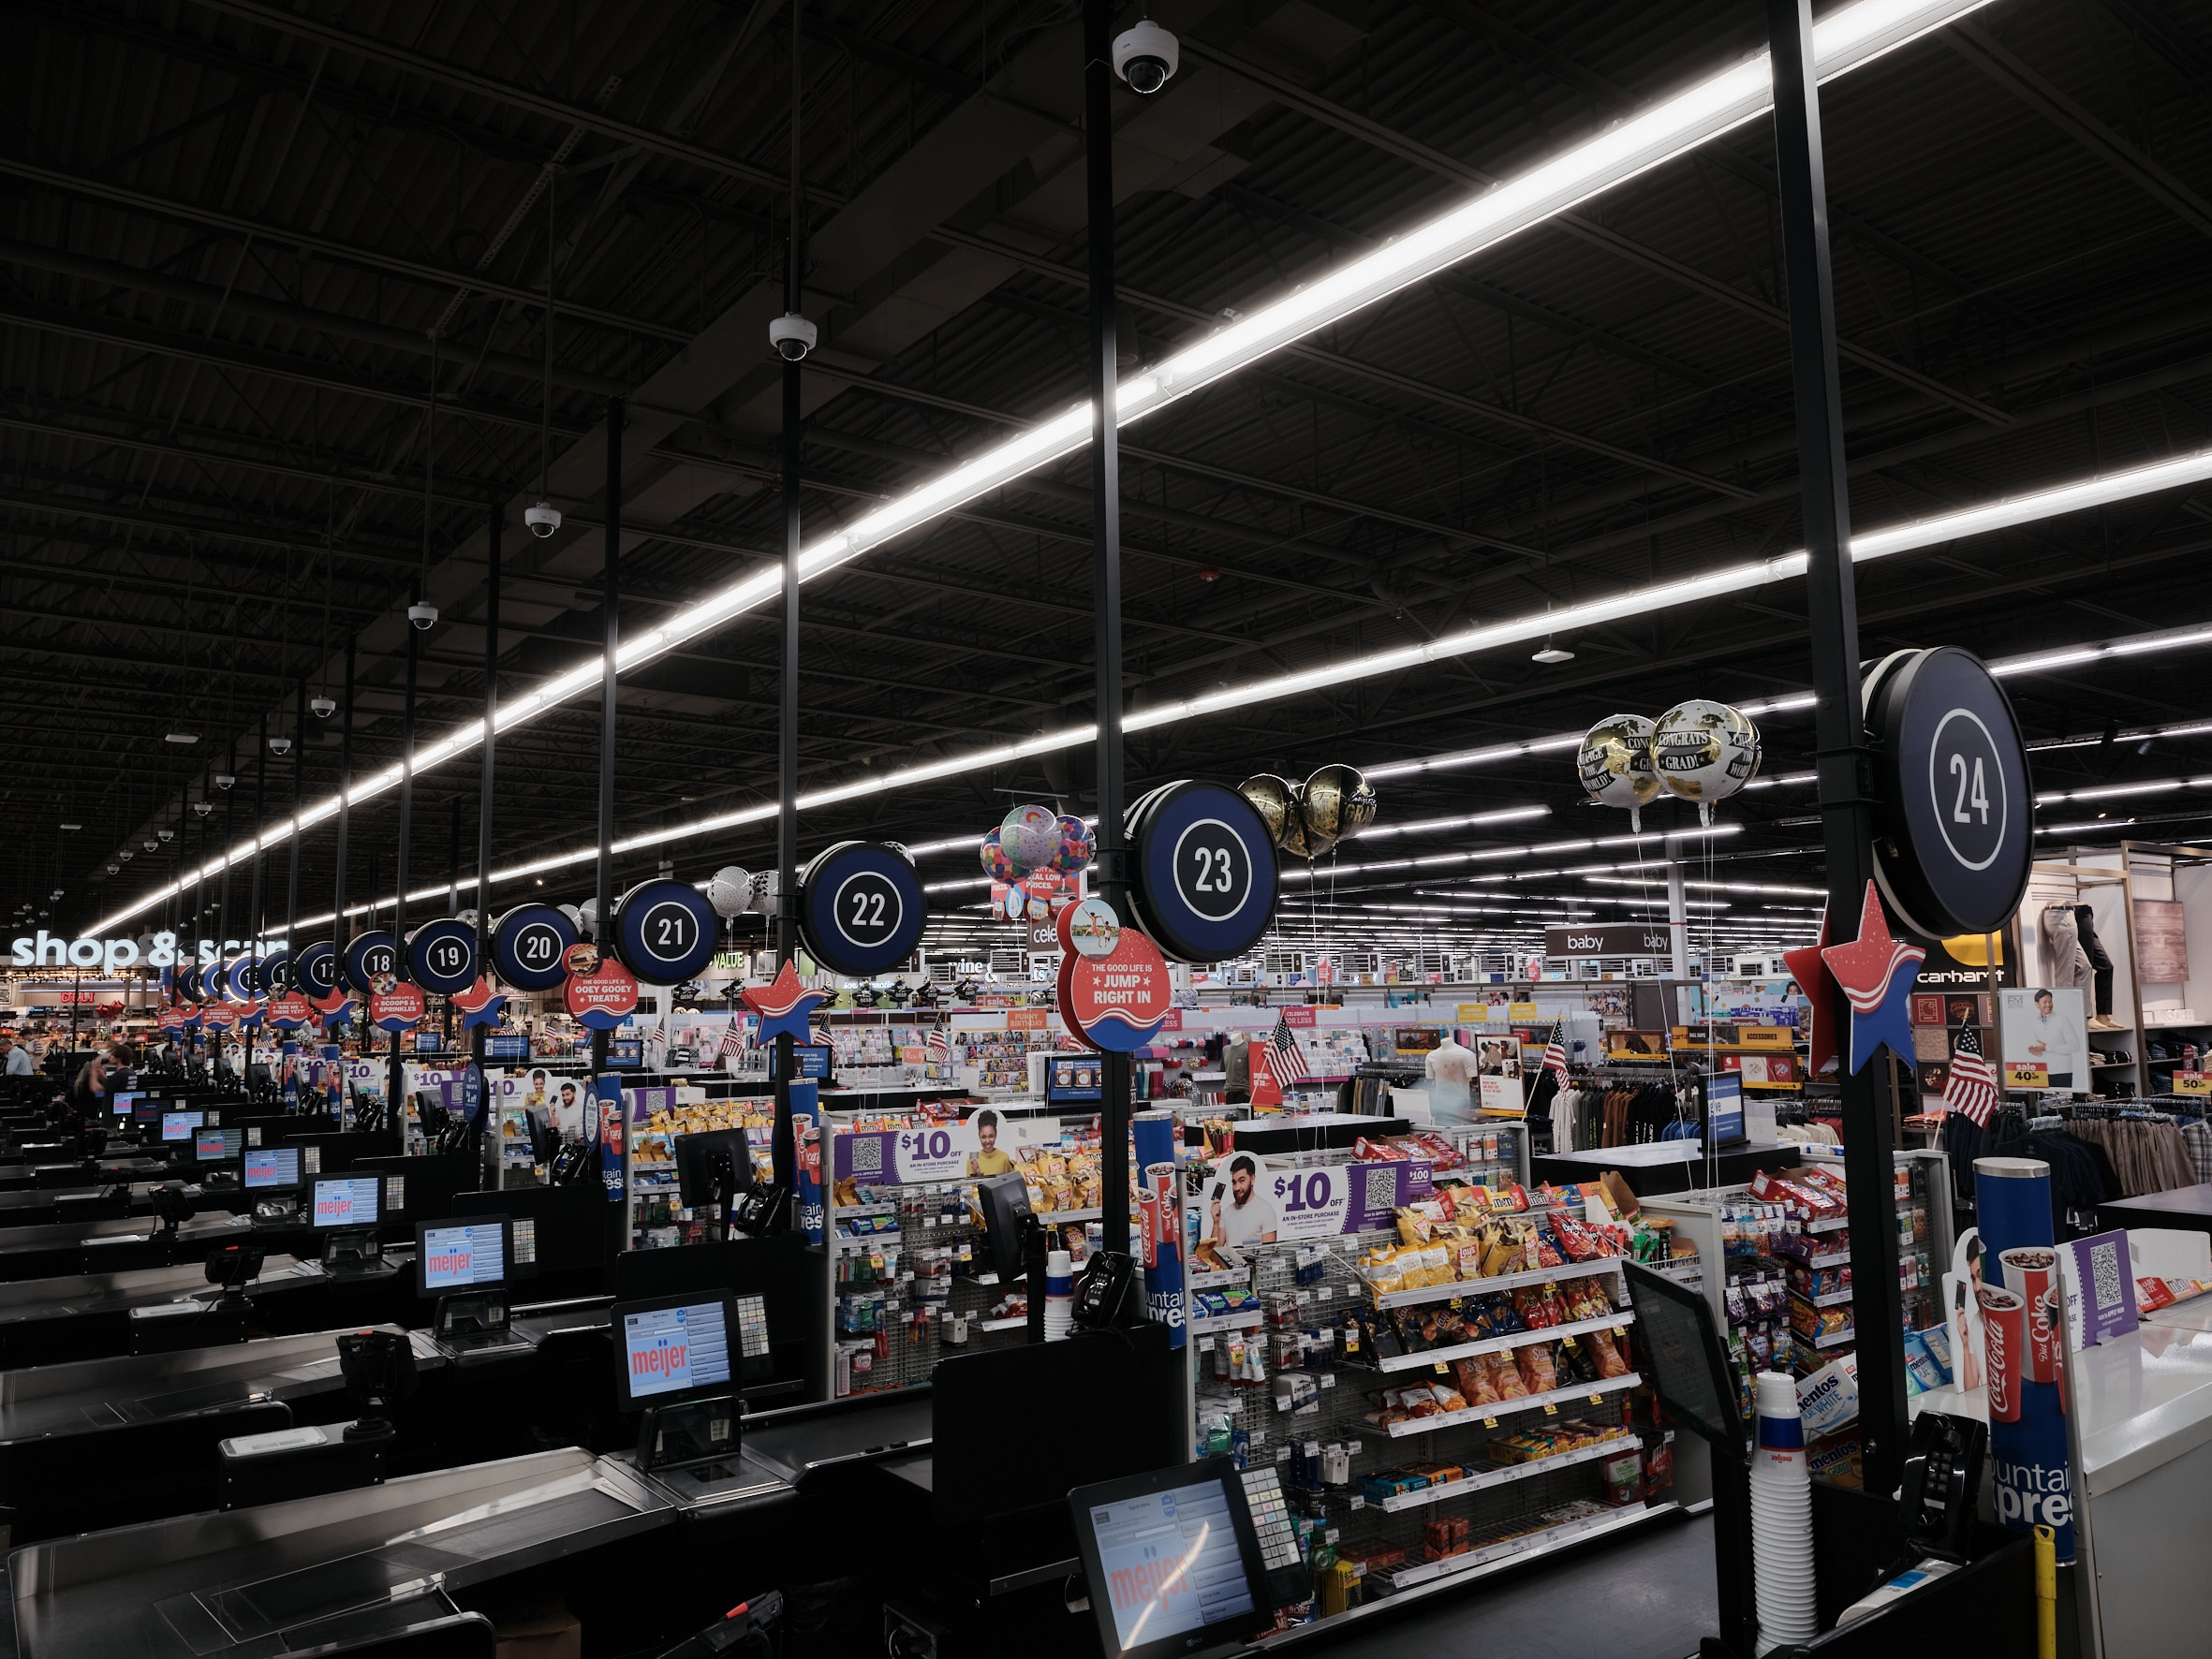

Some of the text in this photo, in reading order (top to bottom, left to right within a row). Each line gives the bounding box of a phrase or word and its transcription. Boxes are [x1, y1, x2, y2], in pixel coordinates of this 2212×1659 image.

[1657, 730, 1708, 747] CONGRATS
[1665, 754, 1700, 771] GRAD!
[1950, 753, 1989, 825] 24
[1045, 874, 1061, 882] LOW
[1194, 846, 1232, 893] 23
[1025, 881, 1054, 889] PRICES.
[852, 892, 886, 927] 22
[657, 918, 684, 946] 21
[526, 936, 551, 959] 20
[1567, 934, 1604, 952] baby
[1644, 933, 1669, 951] baby
[11, 930, 140, 976] shop
[148, 932, 185, 967] &
[437, 947, 460, 967] 19
[714, 952, 744, 969] VALUE
[372, 955, 391, 972] 18
[1129, 964, 1143, 973] LIFE
[1144, 964, 1153, 973] IS
[1103, 975, 1142, 988] JUMP
[1916, 969, 2005, 984] carhart
[61, 991, 96, 1004] DELI
[575, 985, 632, 994] OOEY GOOEY
[1094, 991, 1151, 1004] RIGHT IN
[587, 994, 621, 1003] TREATS
[987, 997, 1004, 1006] sale
[1014, 1012, 1039, 1020] FUNNY
[344, 1064, 371, 1079] $10
[413, 1072, 443, 1086] $10
[2183, 1072, 2204, 1080] sale
[1130, 1075, 1136, 1088] X
[1130, 1093, 1137, 1105] 23
[1710, 1101, 1722, 1117] gve
[165, 1123, 187, 1136] meijer
[199, 1140, 224, 1154] meijer
[901, 1130, 951, 1161] $10
[246, 1163, 277, 1181] meijer
[1408, 1170, 1429, 1181] $100
[1274, 1171, 1344, 1212] $10 OFF
[317, 1197, 353, 1218] meijer
[1160, 1190, 1172, 1218] Coke
[1459, 1244, 1478, 1259] Lay's
[428, 1248, 471, 1276] meijer
[1146, 1288, 1184, 1308] untai
[2030, 1294, 2051, 1363] Diet Coke
[631, 1339, 687, 1378] meijer
[1909, 1353, 1931, 1371] mentos
[1815, 1389, 1843, 1416] WHITE
[1770, 1454, 1792, 1464] meijer
[1810, 1440, 1859, 1470] mentos
[1827, 1461, 1852, 1477] GUM
[1994, 1483, 2073, 1527] pre
[1110, 1545, 1190, 1613] meijer
